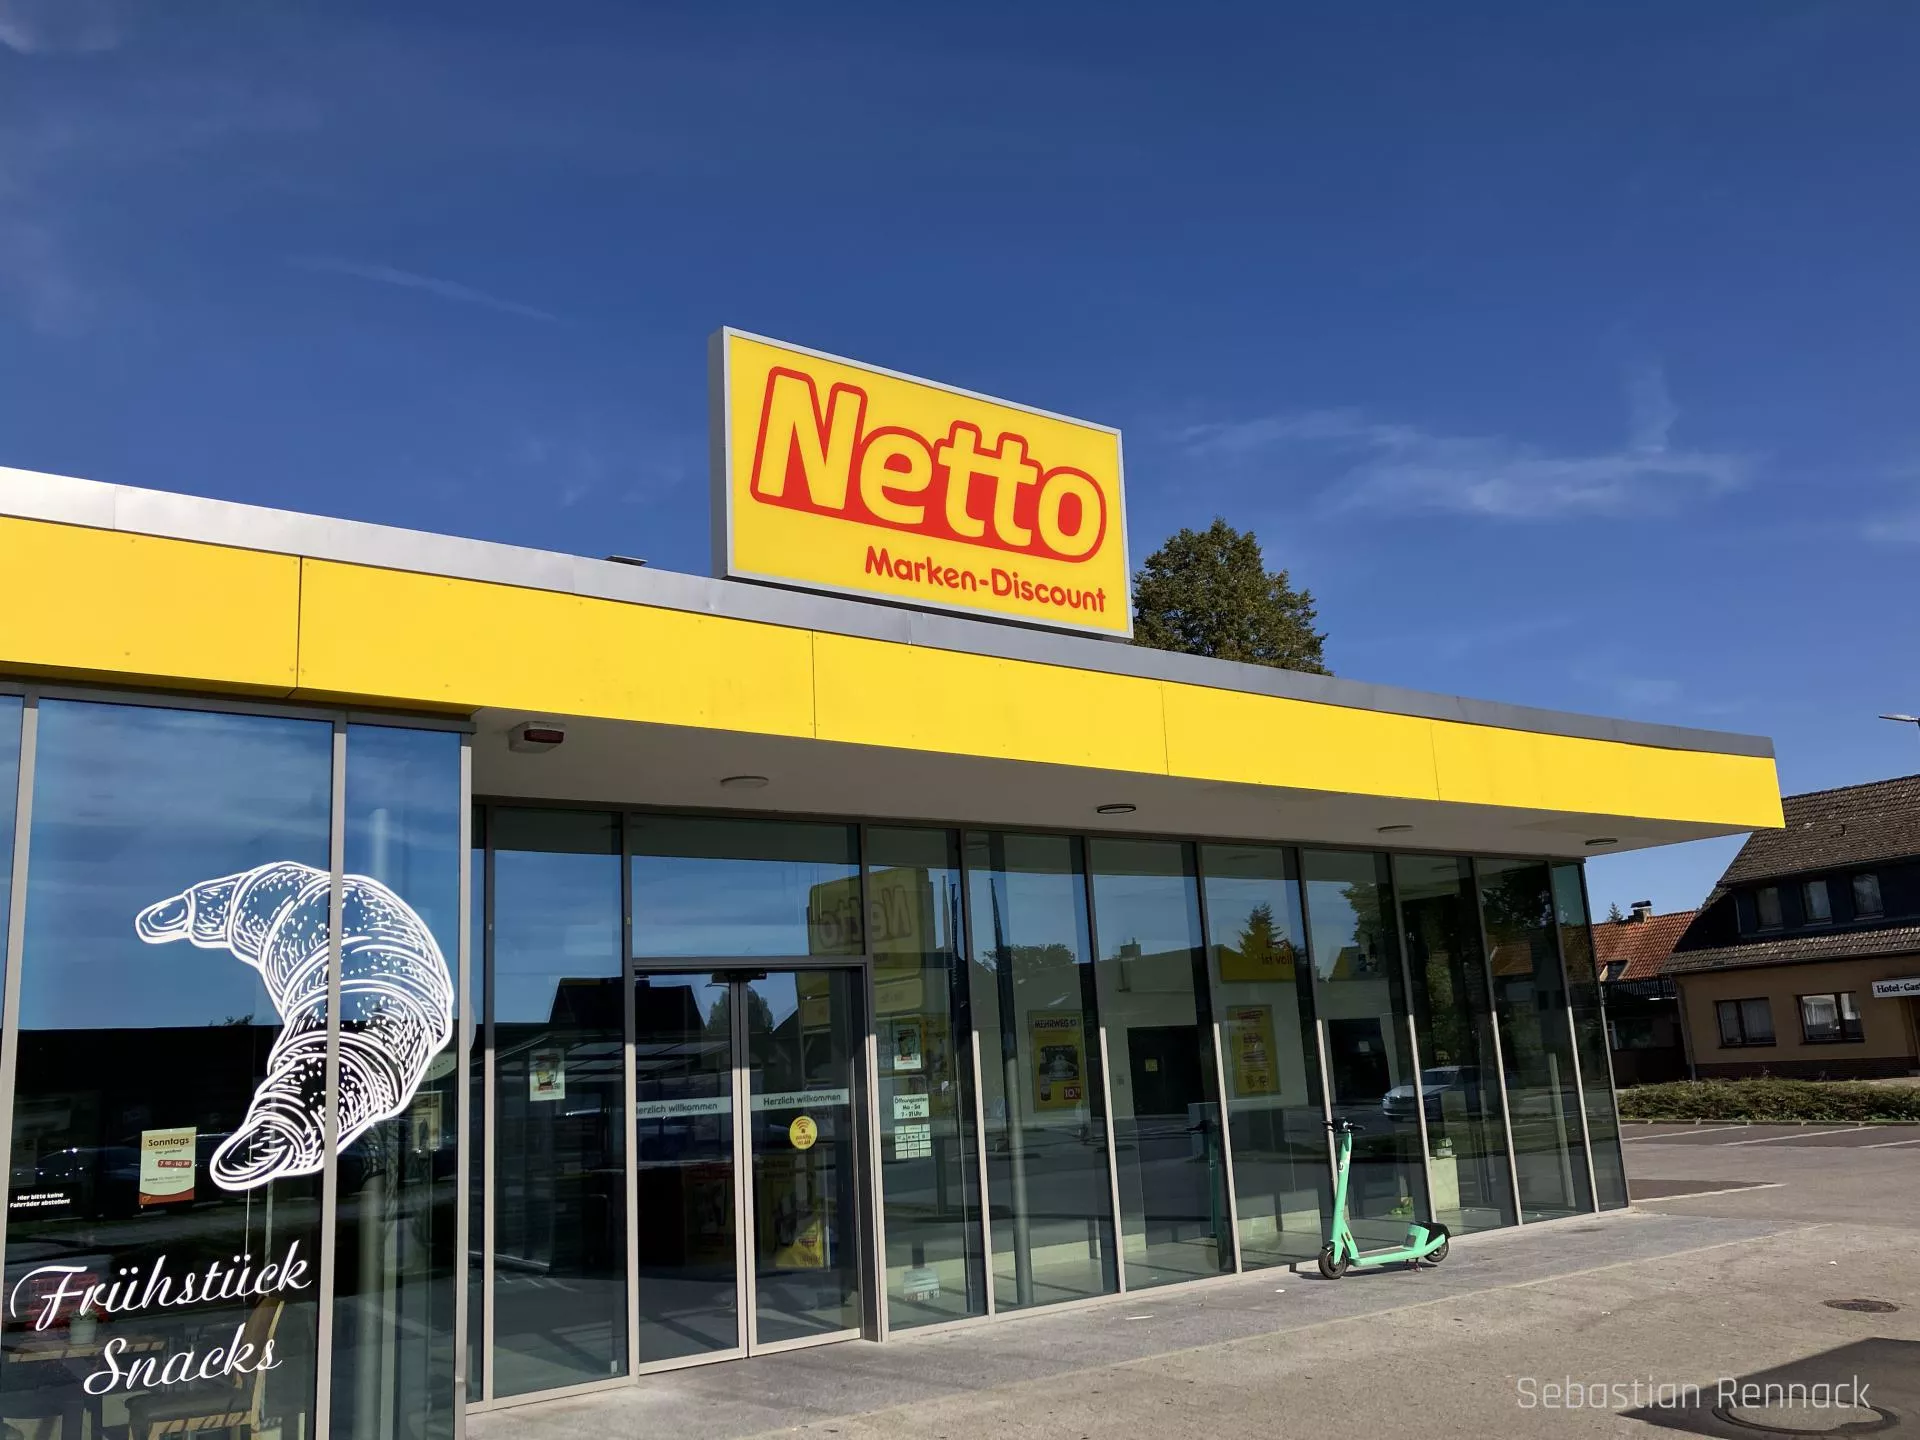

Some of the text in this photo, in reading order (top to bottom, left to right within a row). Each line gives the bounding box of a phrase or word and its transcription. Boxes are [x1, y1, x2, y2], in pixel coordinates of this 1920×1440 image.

[750, 365, 1107, 563] Netto
[864, 545, 1106, 613] Marken-Discount
[667, 1101, 718, 1113] willkommen
[763, 1093, 841, 1106] Herzlich willkommen
[148, 1138, 190, 1147] Sonntags
[10, 1239, 312, 1331] Frühstück
[83, 1323, 283, 1395] Snacks
